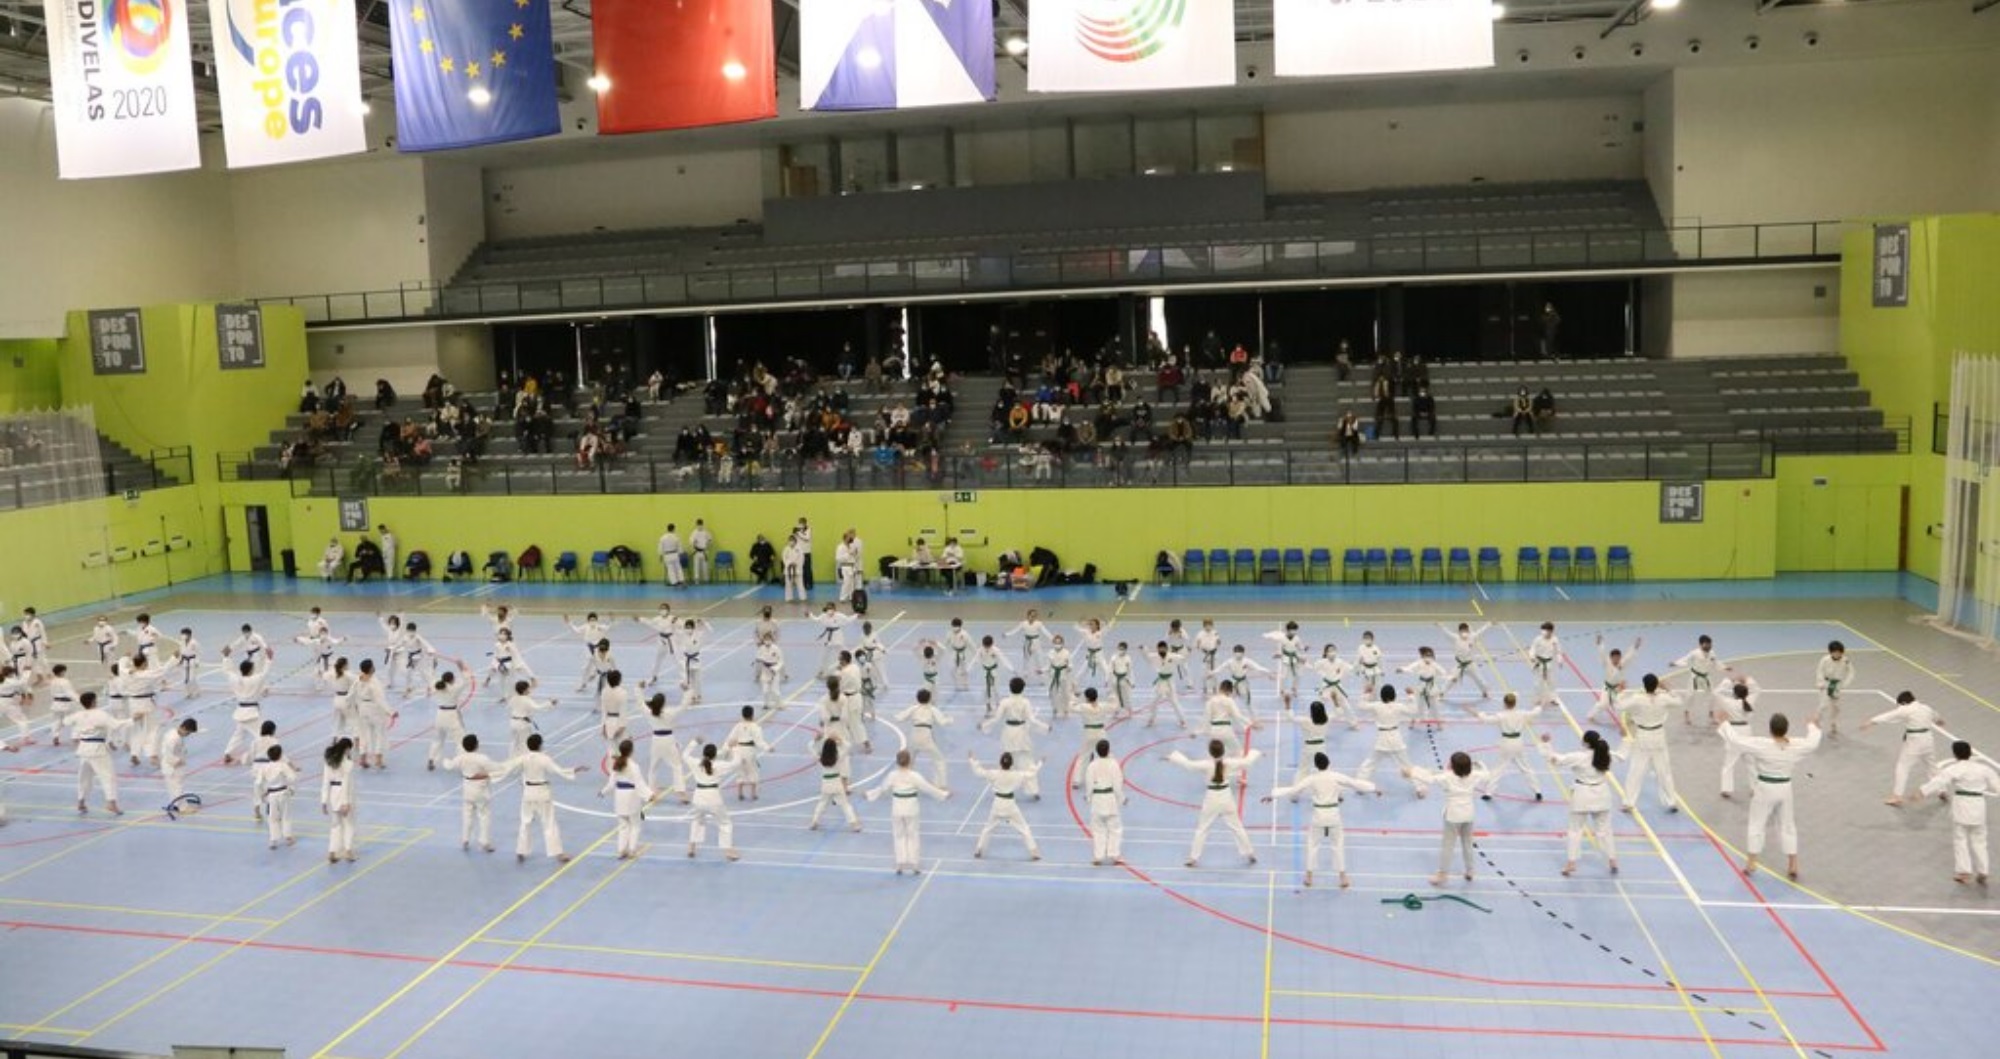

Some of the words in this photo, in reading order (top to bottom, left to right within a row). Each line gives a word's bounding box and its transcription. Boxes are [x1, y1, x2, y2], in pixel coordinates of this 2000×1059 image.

[78, 0, 105, 121] DIVELAS
[279, 0, 323, 135] ces
[112, 85, 167, 120] 2020
[99, 317, 128, 333] DES
[226, 314, 250, 329] DES
[101, 334, 132, 350] POR
[227, 330, 254, 346] POR
[102, 351, 123, 368] TO
[228, 347, 246, 363] TO
